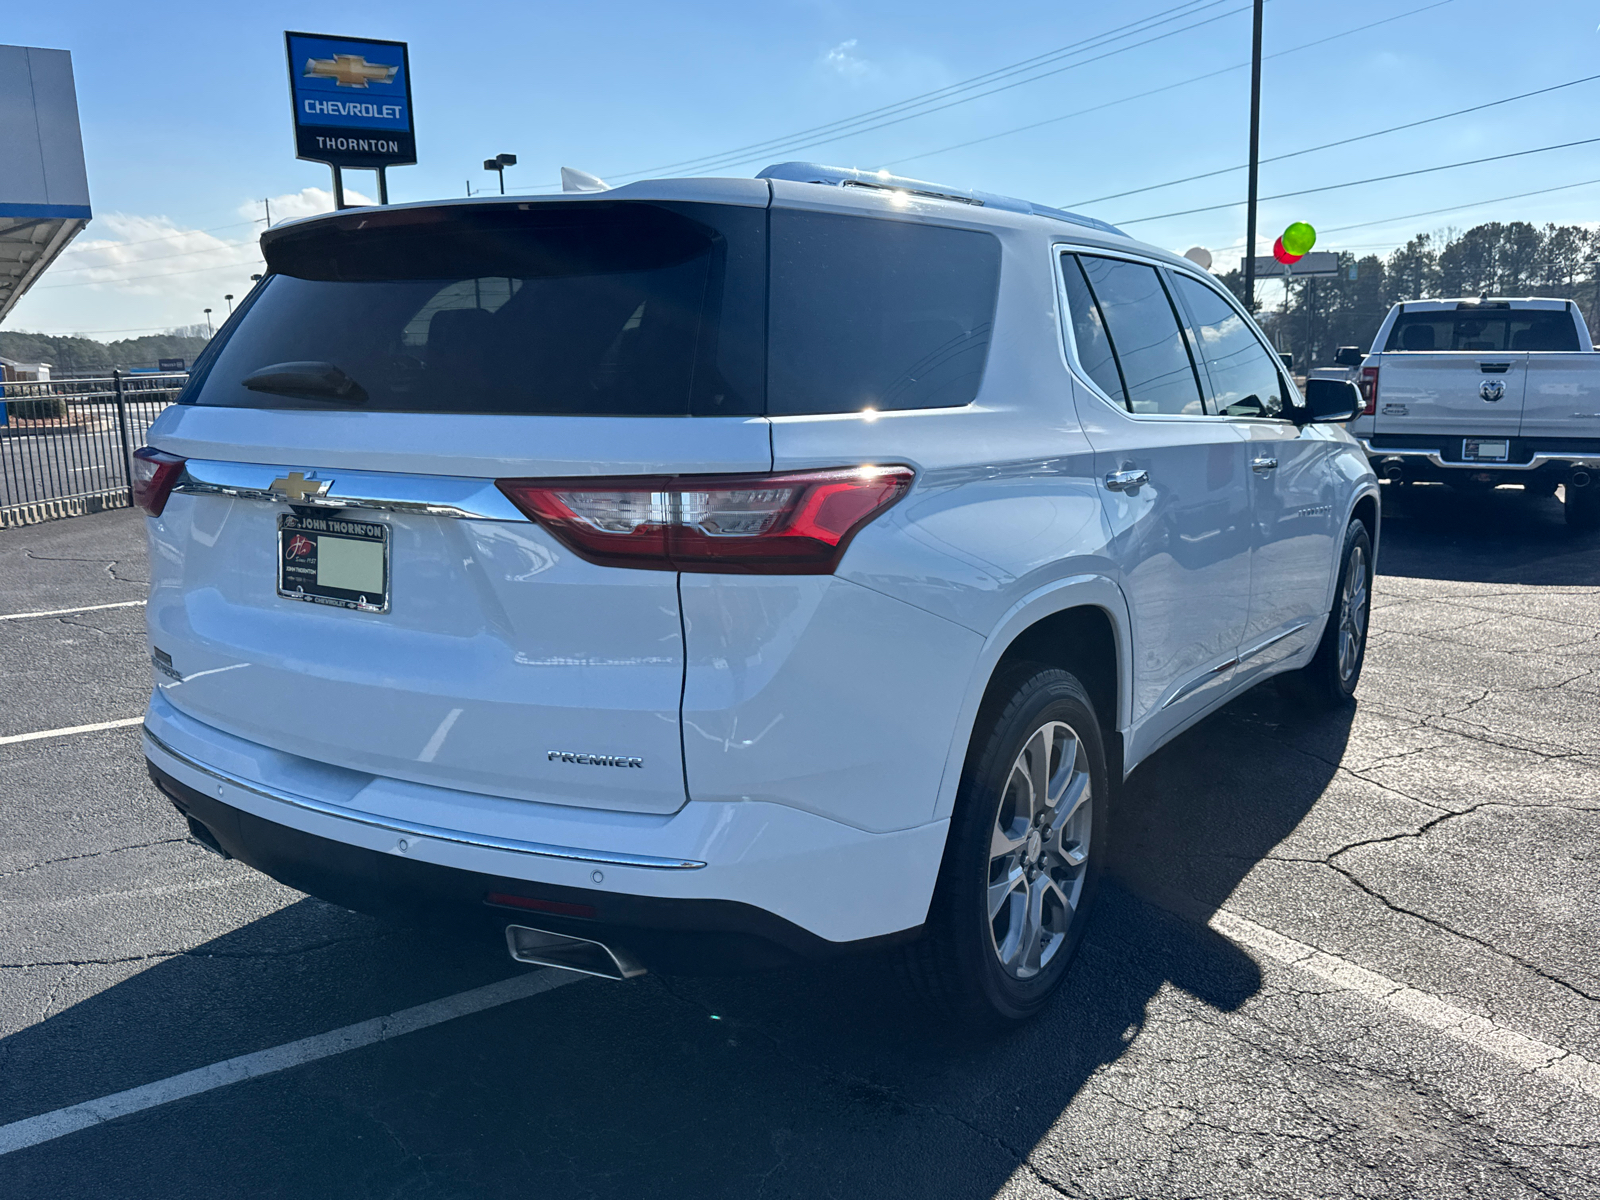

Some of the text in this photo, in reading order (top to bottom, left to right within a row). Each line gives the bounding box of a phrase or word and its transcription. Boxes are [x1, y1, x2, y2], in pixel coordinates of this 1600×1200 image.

[304, 99, 402, 119] CHEVROLET
[316, 136, 399, 153] THORNTON
[302, 518, 326, 530] JOHN
[328, 521, 380, 537] THORNTON
[314, 597, 346, 607] CHEVROLET
[547, 750, 643, 768] PREMIER
